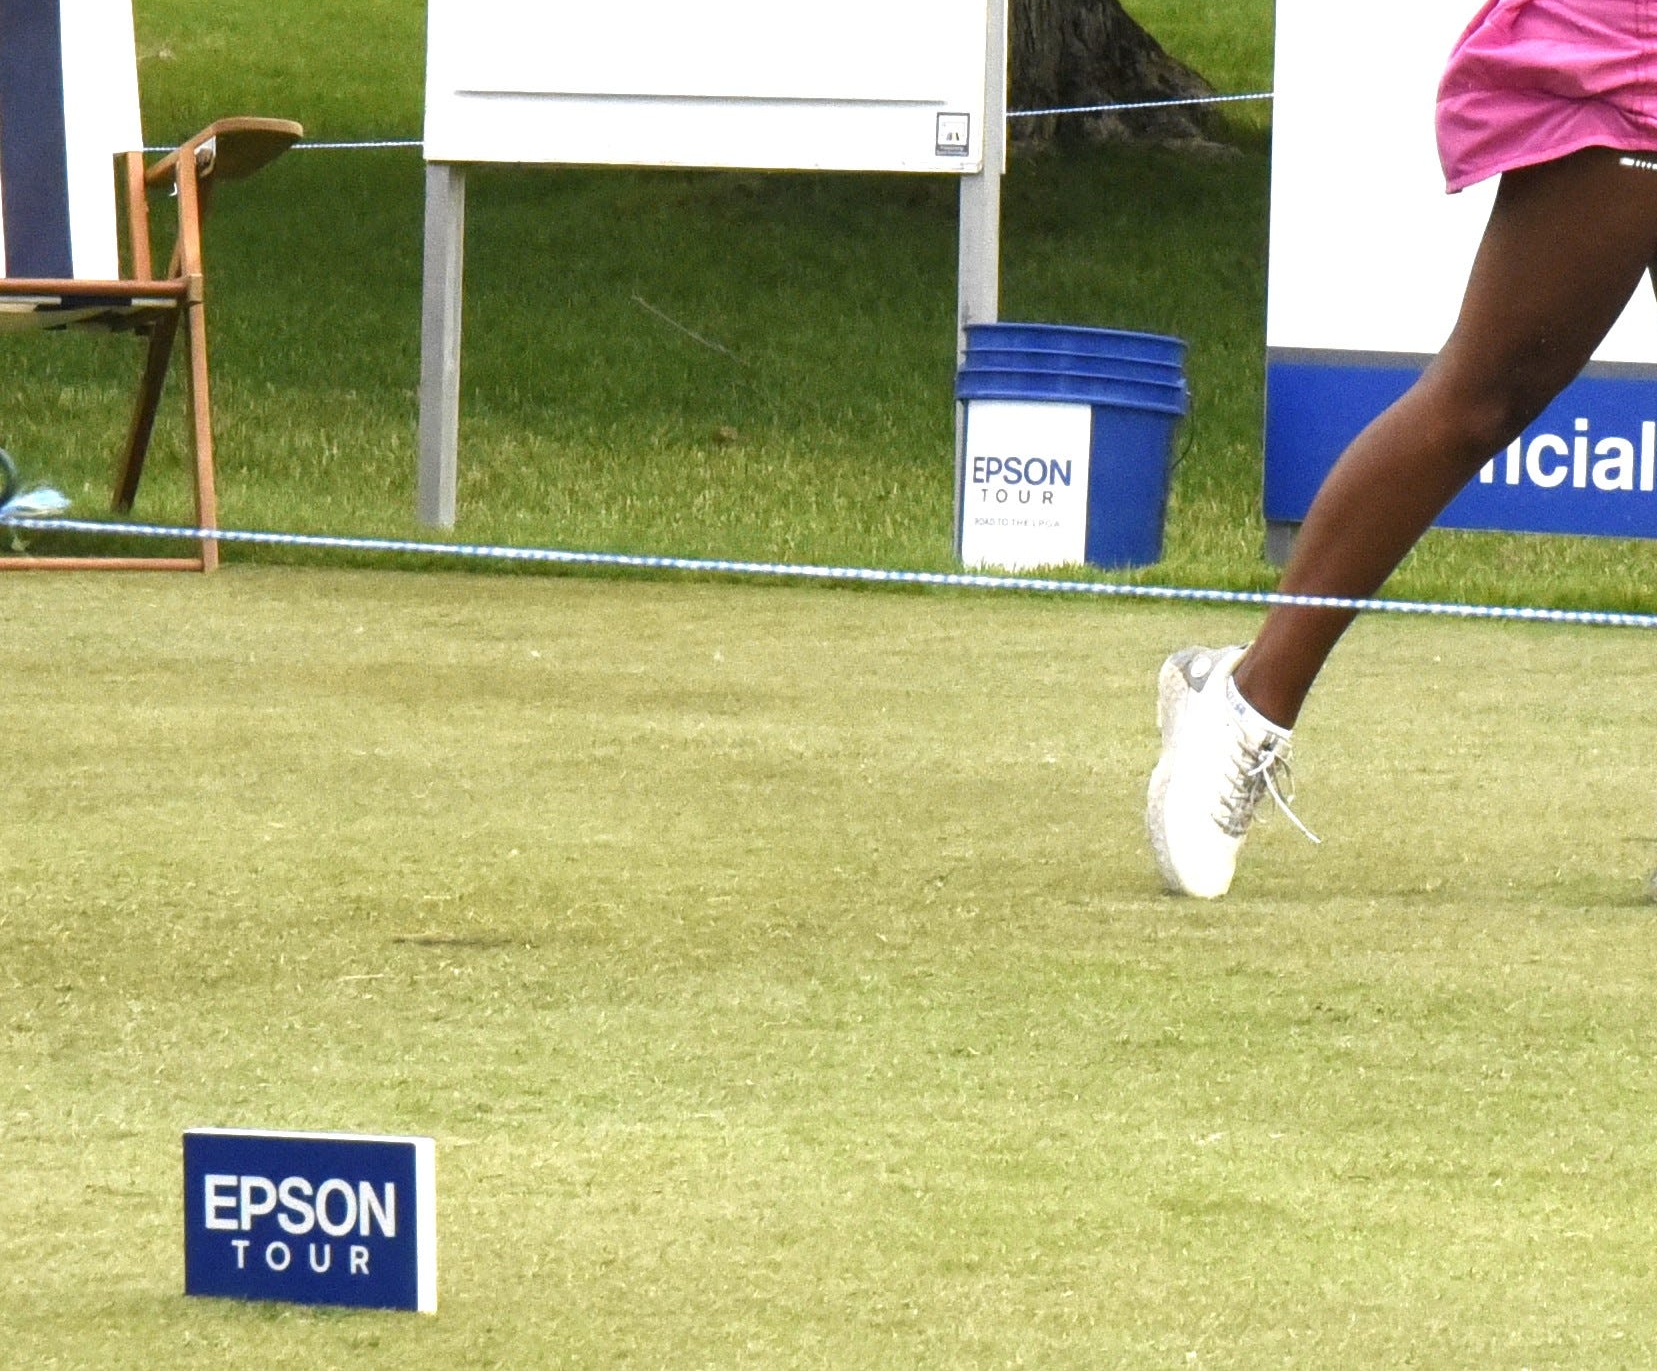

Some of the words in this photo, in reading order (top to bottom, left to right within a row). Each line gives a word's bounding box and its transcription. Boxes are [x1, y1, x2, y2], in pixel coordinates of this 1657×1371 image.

[973, 457, 1072, 486] EPSON
[1480, 418, 1655, 492] icial
[981, 488, 1054, 505] TOUR
[204, 1173, 396, 1238] EPSON
[231, 1239, 370, 1276] TOUR
